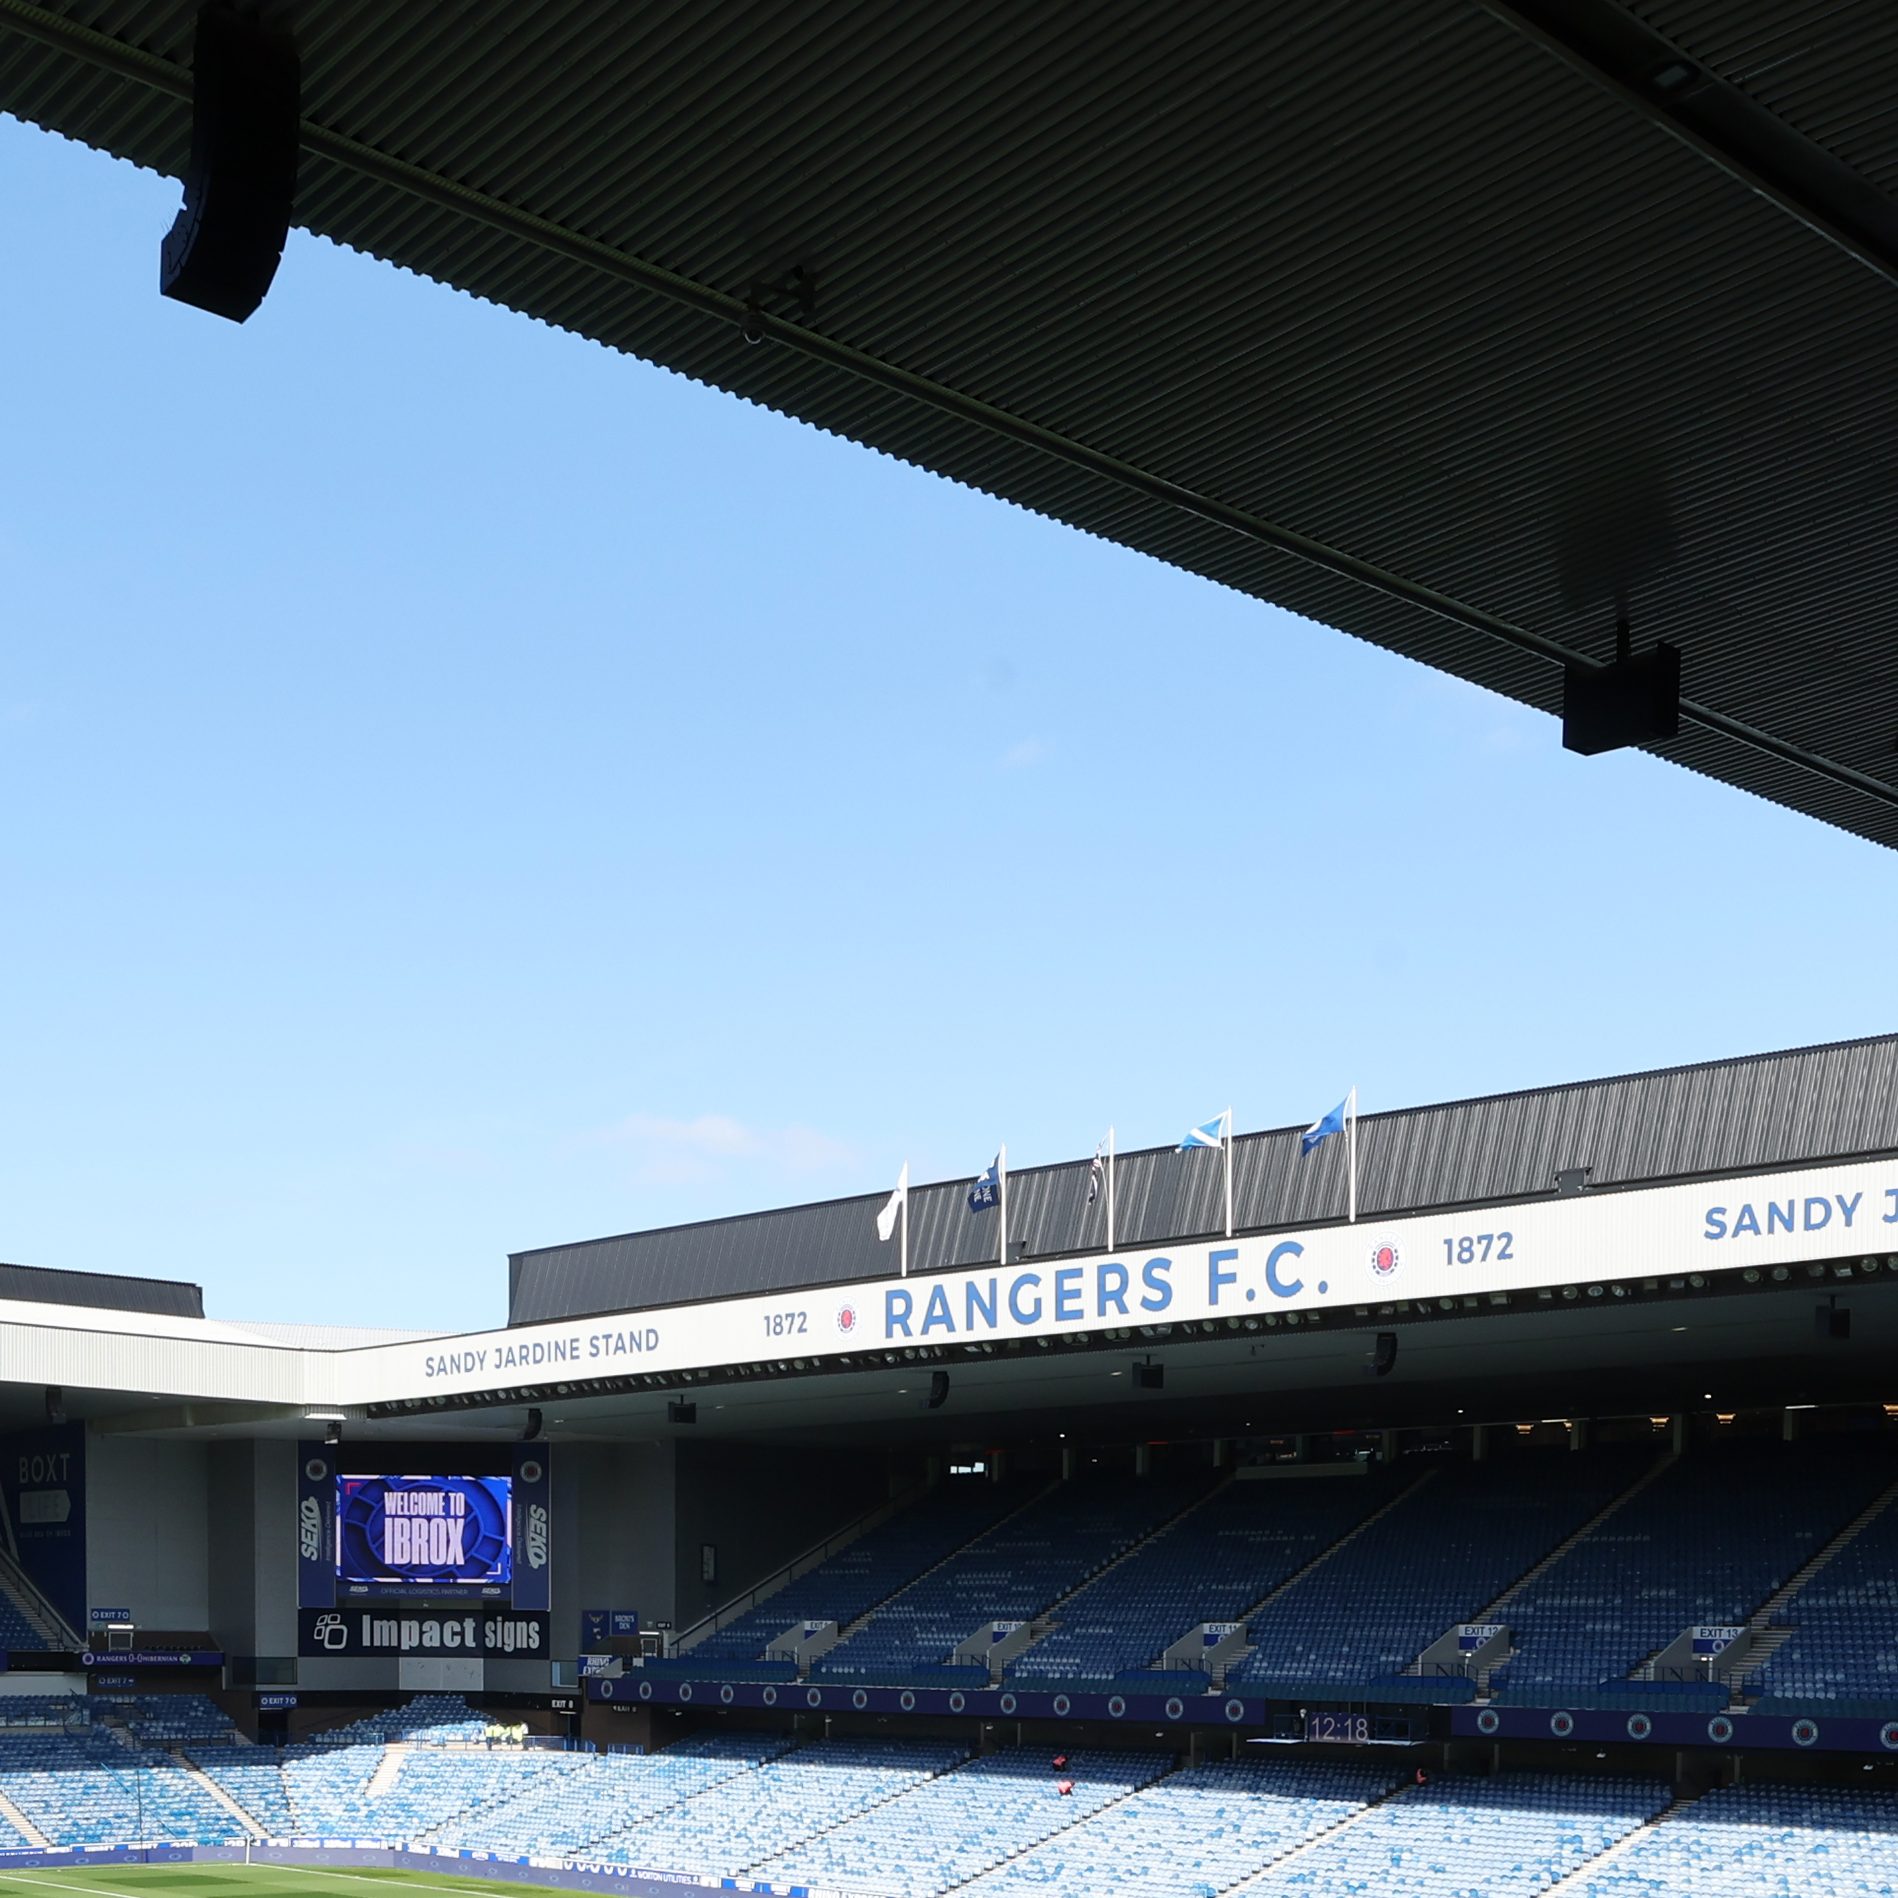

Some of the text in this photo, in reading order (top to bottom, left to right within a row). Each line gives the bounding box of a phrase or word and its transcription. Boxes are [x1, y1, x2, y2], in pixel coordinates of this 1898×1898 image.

[1704, 1192, 1862, 1240] SANDY
[1444, 1232, 1514, 1266] 1872
[885, 1240, 1330, 1339] RANGERS F.C.
[763, 1311, 809, 1337] 1872
[425, 1328, 660, 1378] SANDY JARDINE STAND
[19, 1453, 70, 1484] BOXT
[384, 1491, 465, 1516] WELCOME TO
[300, 1496, 321, 1562] SEKO
[384, 1517, 465, 1565] IBROX
[529, 1504, 548, 1569] SEKO
[99, 1611, 116, 1619] EXIT
[362, 1614, 540, 1652] Impact signs
[1209, 1625, 1227, 1633] EXIT
[1464, 1627, 1499, 1636] EXIT 12
[1700, 1629, 1739, 1638] EXIT 13
[96, 1655, 128, 1663] RANGERS
[143, 1655, 179, 1663] HIBERNIAN
[268, 1697, 284, 1705] EXIT
[551, 1700, 567, 1709] EXIT
[1311, 1717, 1368, 1741] 12:18
[663, 1872, 693, 1886] UTILITIES
